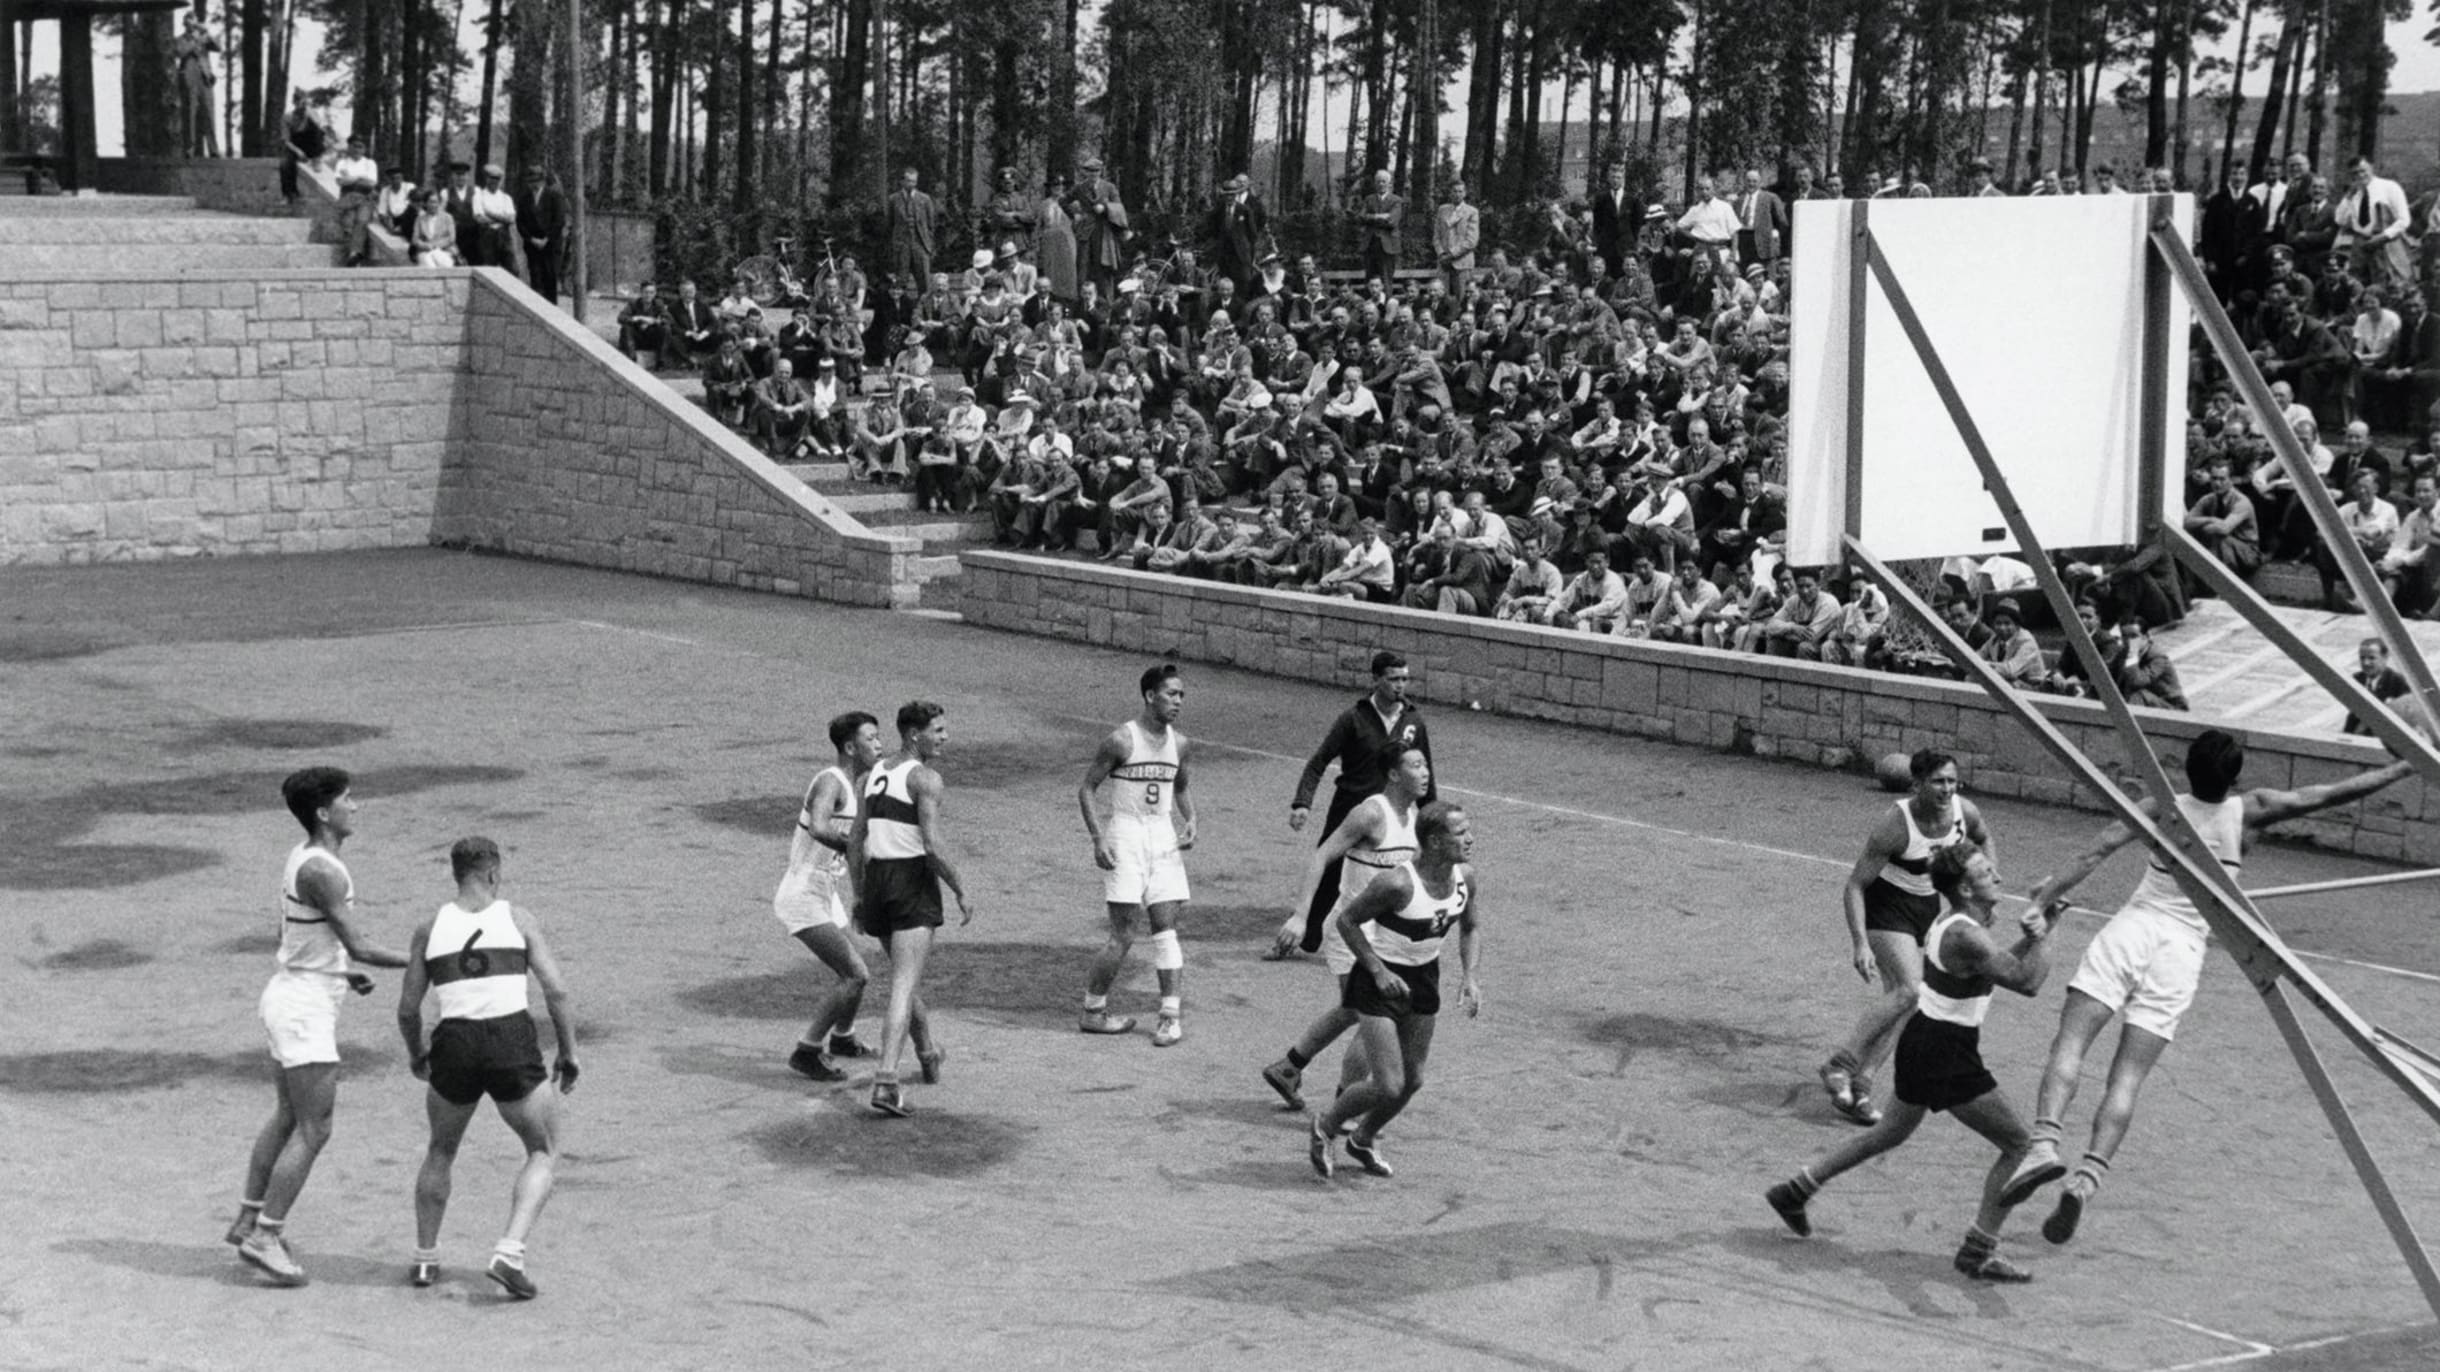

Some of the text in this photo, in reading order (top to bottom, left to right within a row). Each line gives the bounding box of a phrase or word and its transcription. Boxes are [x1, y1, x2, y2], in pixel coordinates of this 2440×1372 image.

[1145, 783, 1160, 805] 9
[1457, 882, 1466, 908] 5
[458, 928, 489, 978] 6
